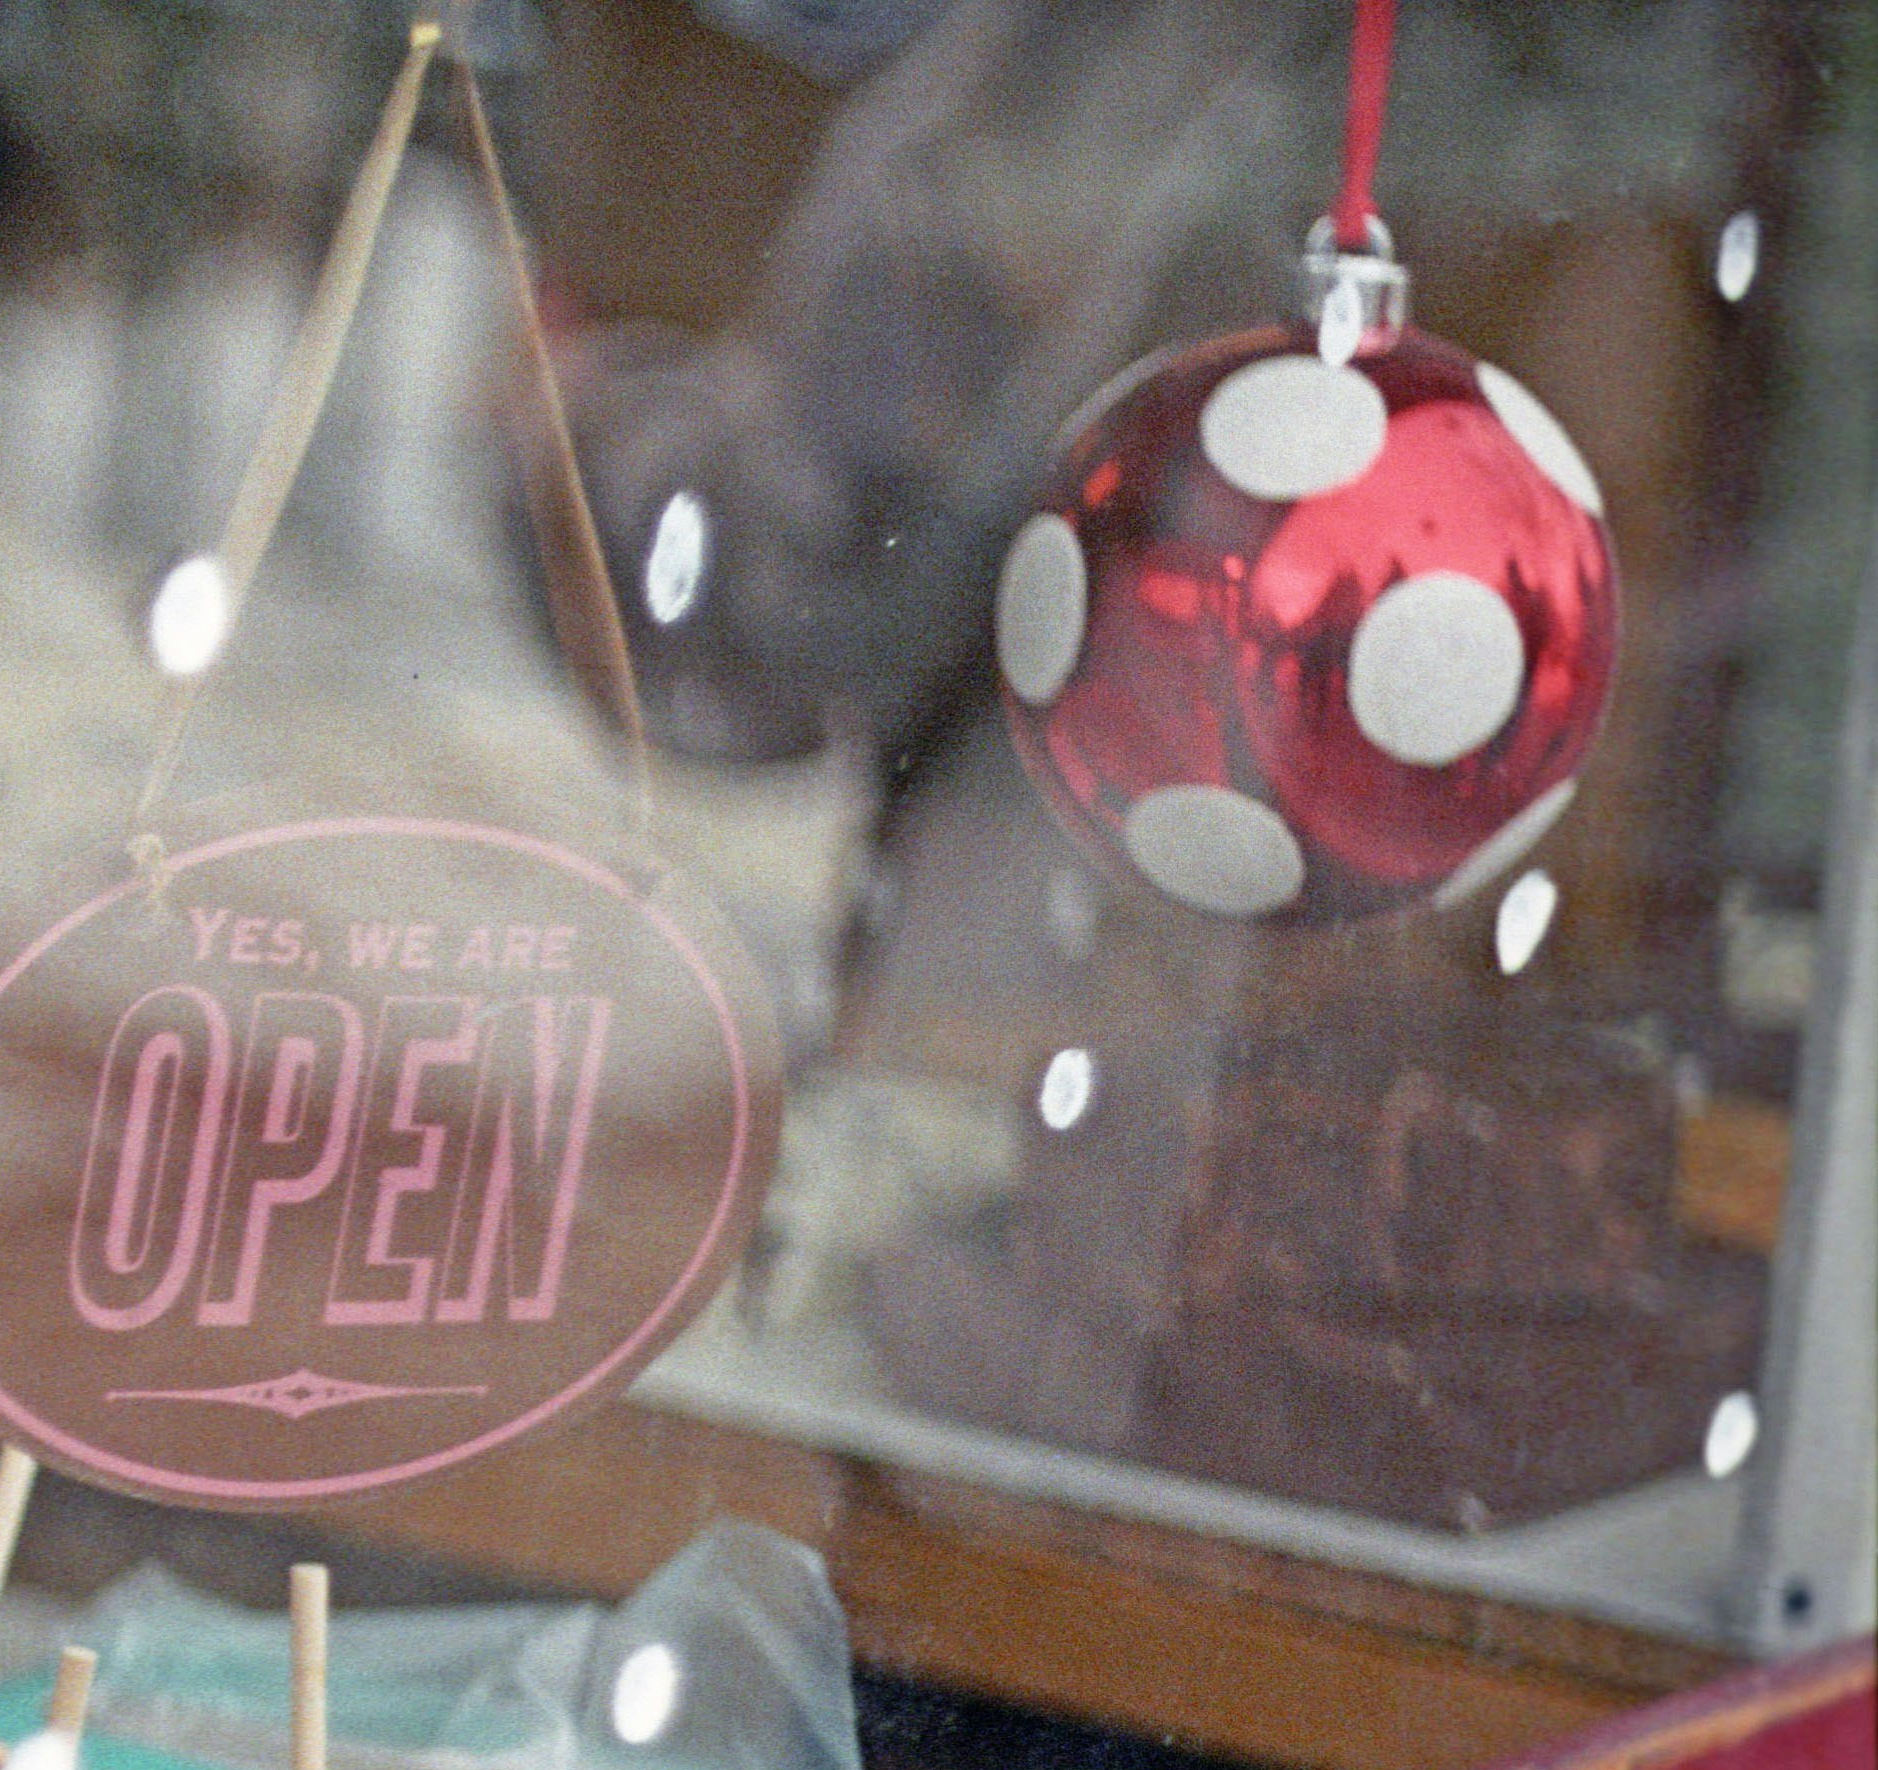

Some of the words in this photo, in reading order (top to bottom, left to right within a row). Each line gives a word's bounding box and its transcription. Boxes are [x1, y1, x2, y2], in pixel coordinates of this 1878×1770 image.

[187, 906, 318, 973] YES,
[346, 921, 439, 970] WE
[456, 924, 578, 971] ARE
[68, 983, 614, 1332] OPEN
